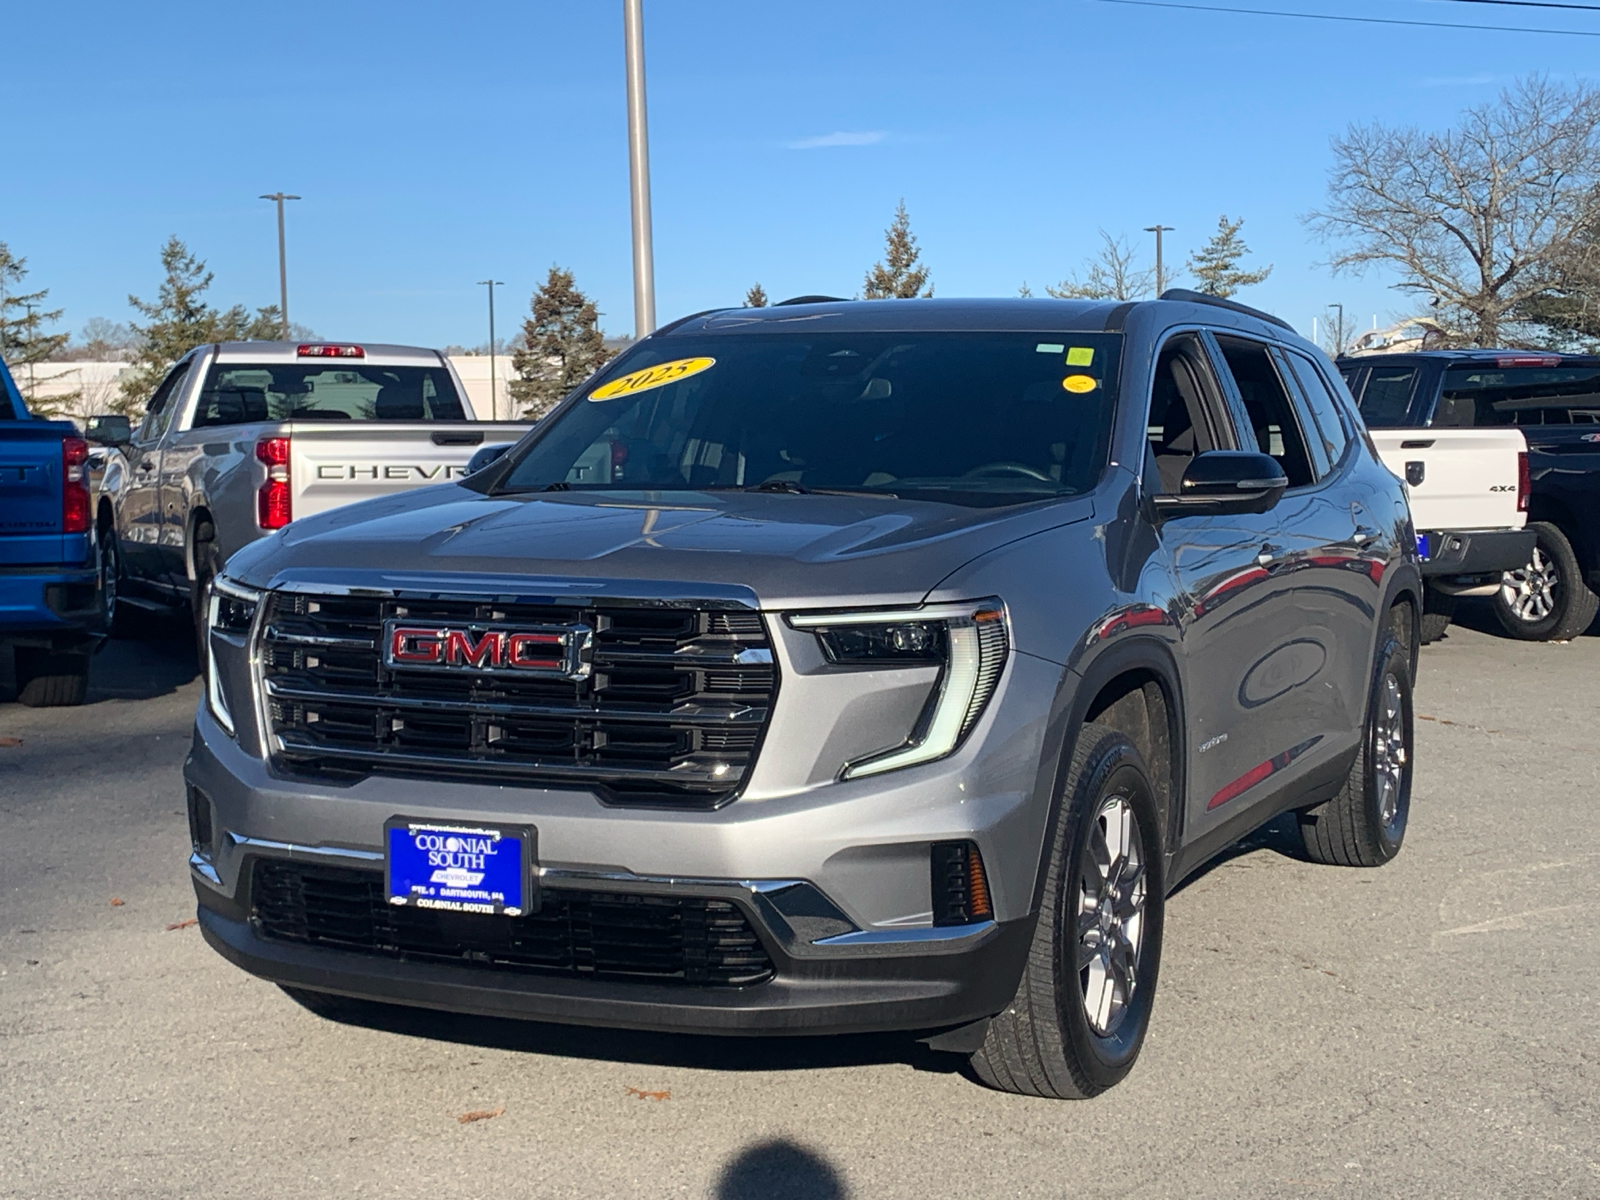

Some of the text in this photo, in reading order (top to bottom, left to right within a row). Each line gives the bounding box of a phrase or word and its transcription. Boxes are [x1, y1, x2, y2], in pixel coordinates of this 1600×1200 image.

[608, 360, 695, 396] 2025
[393, 627, 564, 668] GMC
[415, 834, 498, 855] COLONIAL
[428, 851, 485, 869] SOUTH
[436, 870, 479, 882] CHEVROLET
[416, 898, 494, 914] COLONIAL SOUTH
